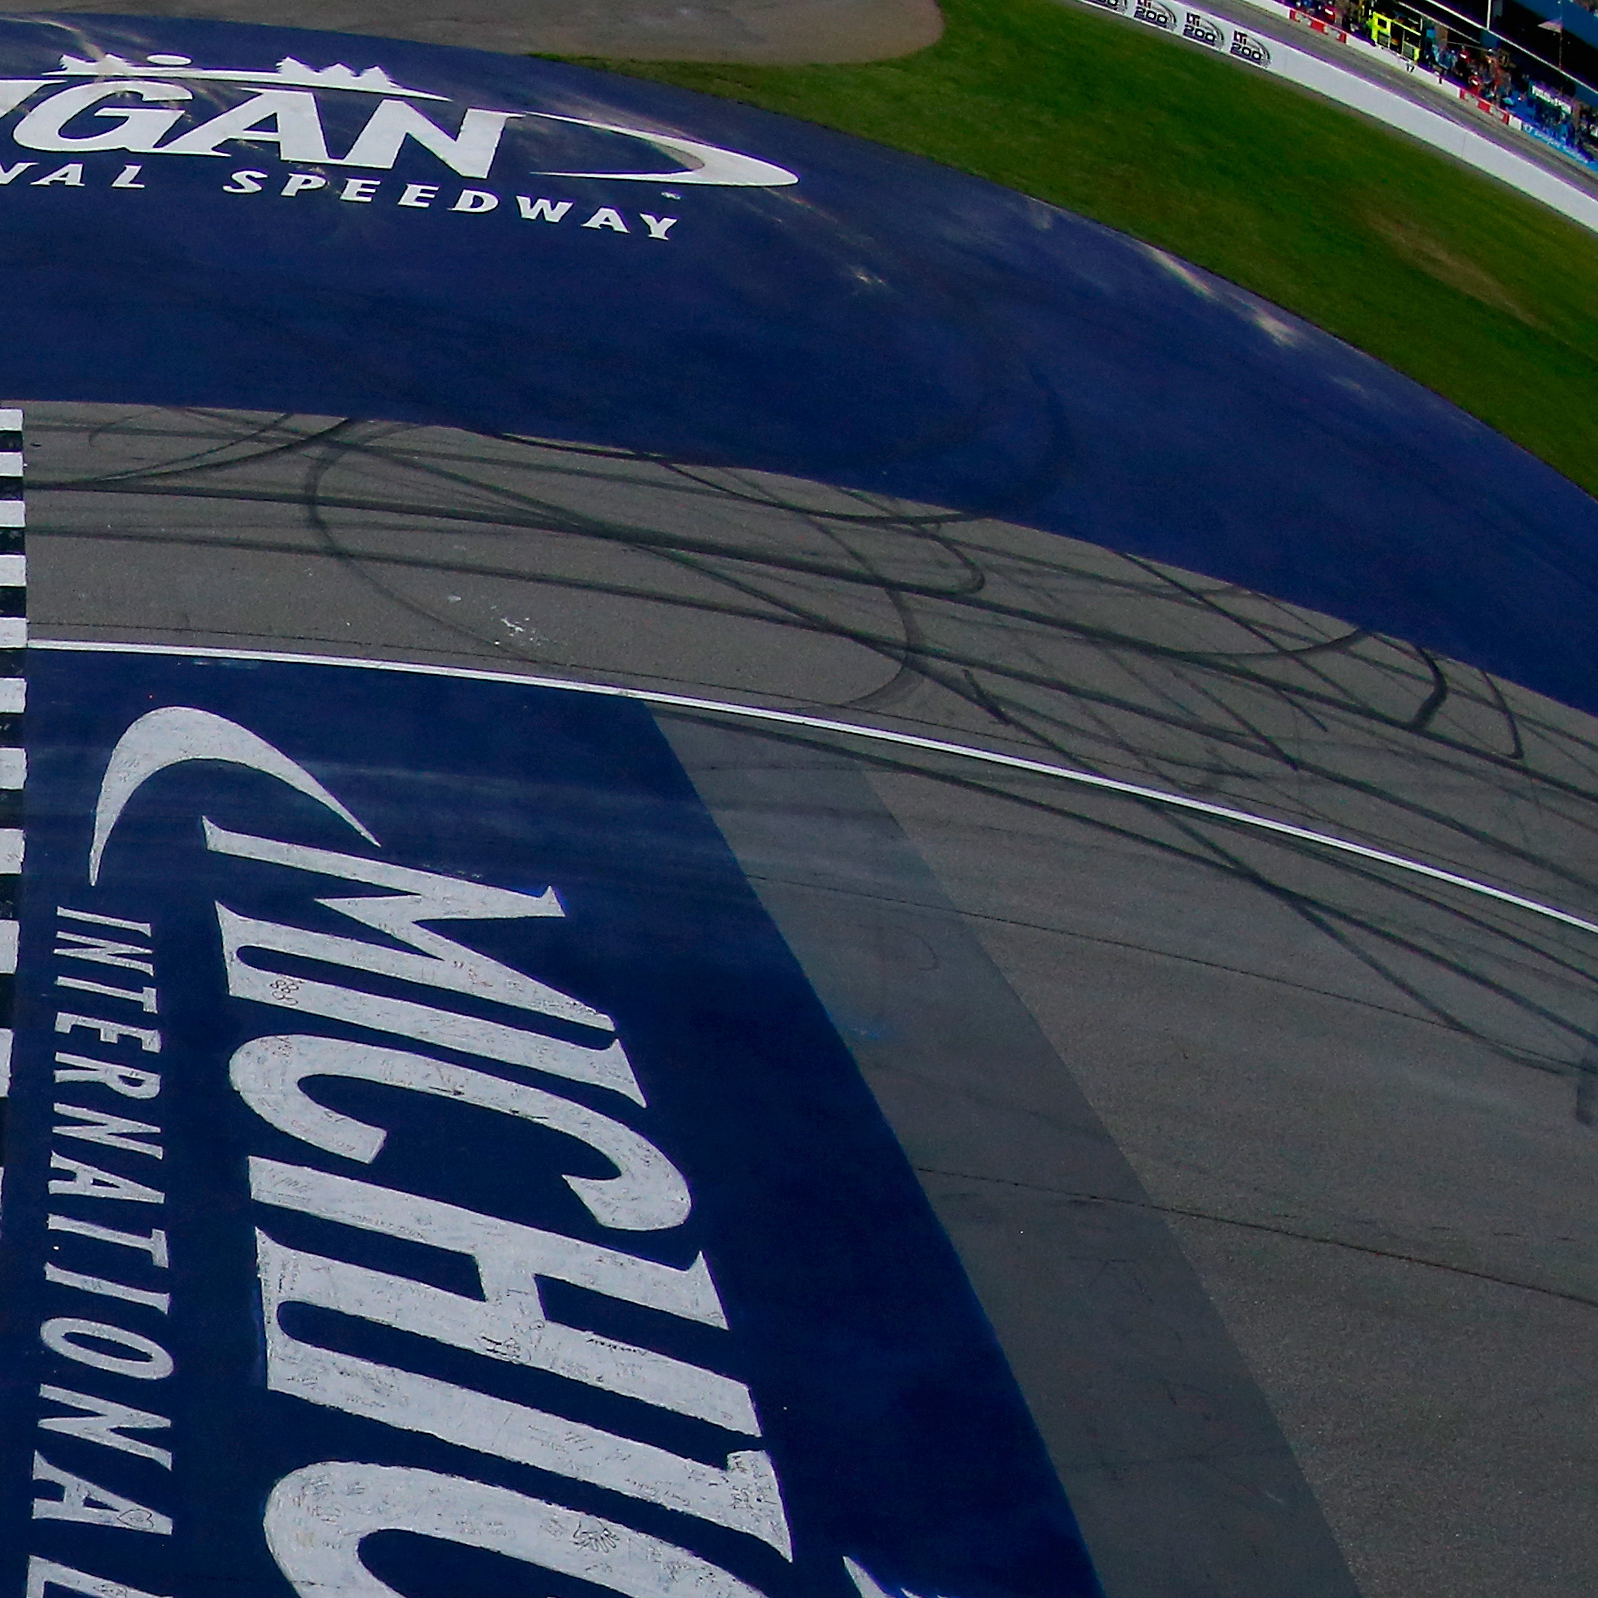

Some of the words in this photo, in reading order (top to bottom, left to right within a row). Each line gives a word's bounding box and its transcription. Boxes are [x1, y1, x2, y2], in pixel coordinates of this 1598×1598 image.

[1183, 25, 1216, 42] 200
[1230, 43, 1262, 60] 200
[222, 168, 680, 240] SPEEDWAY
